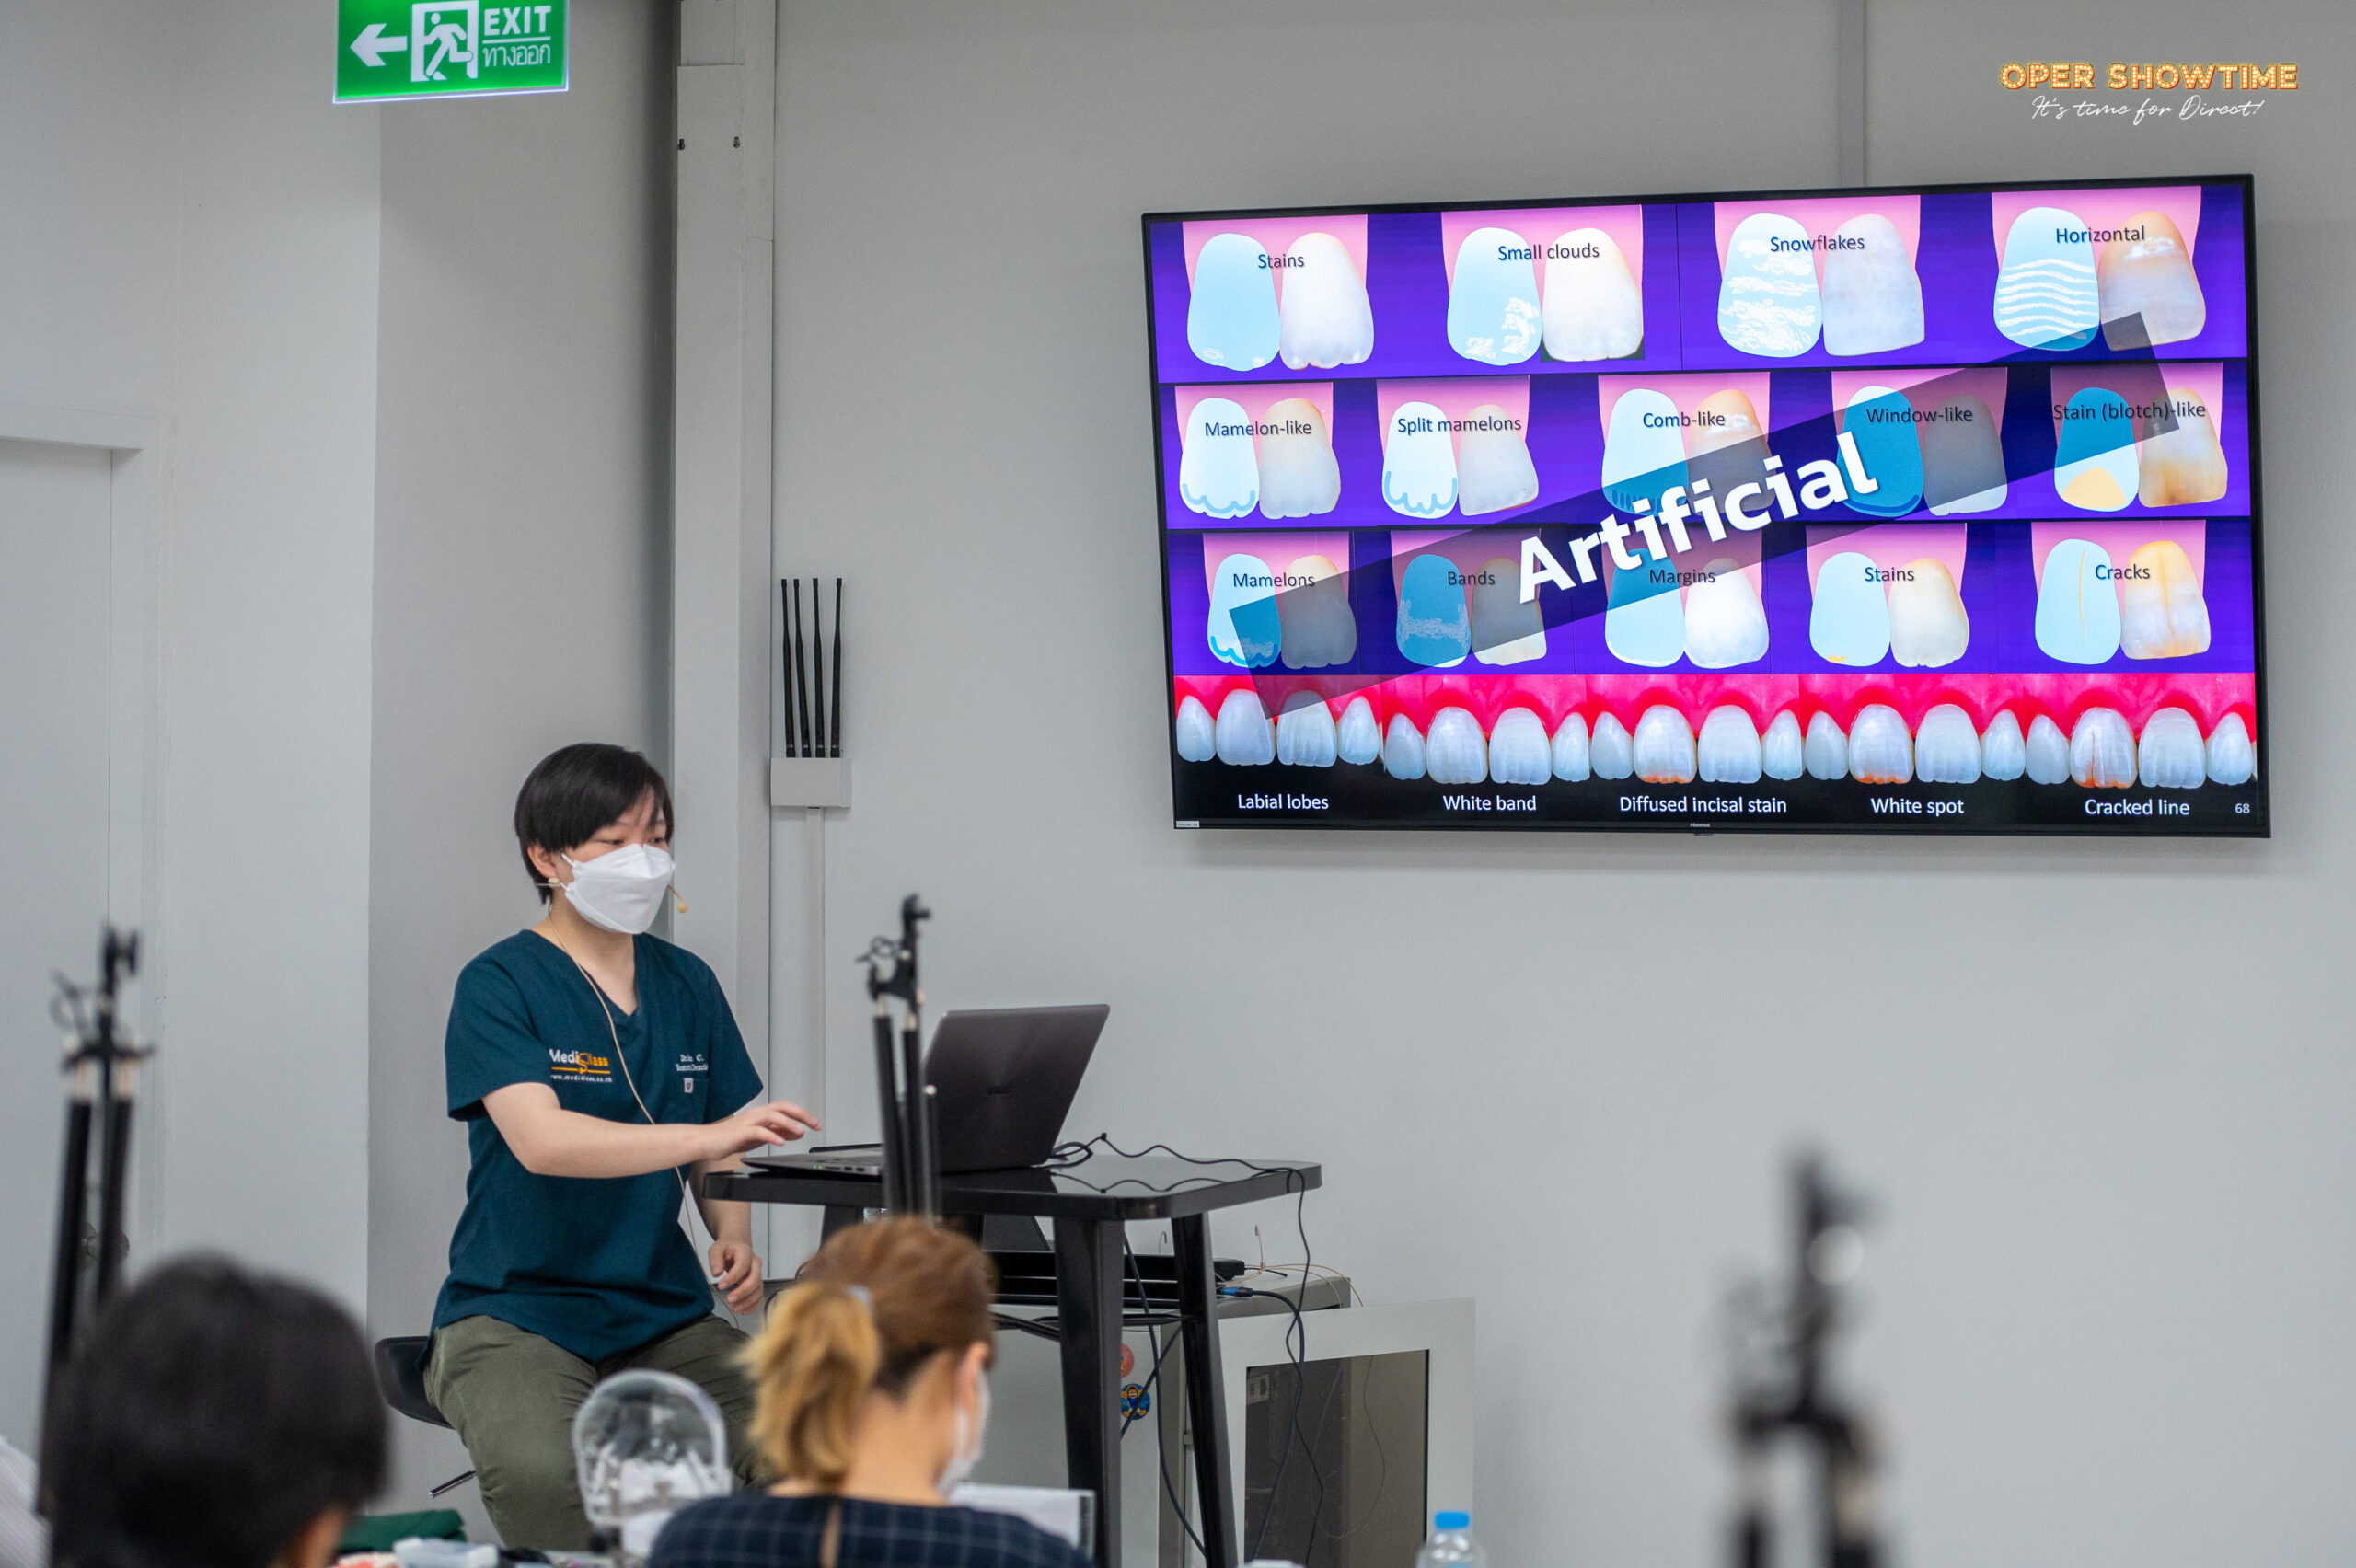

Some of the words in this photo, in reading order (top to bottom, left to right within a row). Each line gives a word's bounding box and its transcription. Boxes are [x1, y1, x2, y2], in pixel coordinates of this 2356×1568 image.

[484, 6, 551, 36] EXIT
[482, 44, 551, 67] ทางออก
[1770, 235, 1865, 252] Snowflakes
[2056, 225, 2146, 244] Horizontal
[1497, 244, 1542, 261] Small
[1546, 242, 1600, 260] clouds
[1258, 253, 1305, 270] Stains
[1643, 411, 1726, 429] Comb-like
[1866, 407, 1973, 423] Window-like
[2053, 403, 2096, 421] Stain
[2101, 401, 2206, 421] (blotch)-like
[1205, 419, 1312, 437] Mamelon-like
[1397, 417, 1432, 437] Split
[1437, 416, 1522, 432] mamelons
[1520, 431, 1879, 604] Artificial
[1233, 571, 1315, 589] Mamelons
[1447, 571, 1496, 587] Bands
[1649, 568, 1715, 587] Margins
[1865, 566, 1915, 582] Stains
[2095, 564, 2151, 582] Cracks
[1238, 794, 1283, 810] Labial
[1287, 795, 1329, 810] lobes
[1443, 796, 1494, 812] White
[1497, 796, 1536, 812] band
[1620, 796, 1687, 813] Diffused
[1692, 798, 1743, 813] incisal
[1748, 798, 1786, 813] stain
[1871, 798, 1921, 814] White
[1925, 801, 1964, 818] spot
[2085, 799, 2154, 816] Cracked
[2158, 800, 2190, 816] line
[2235, 803, 2250, 814] 68
